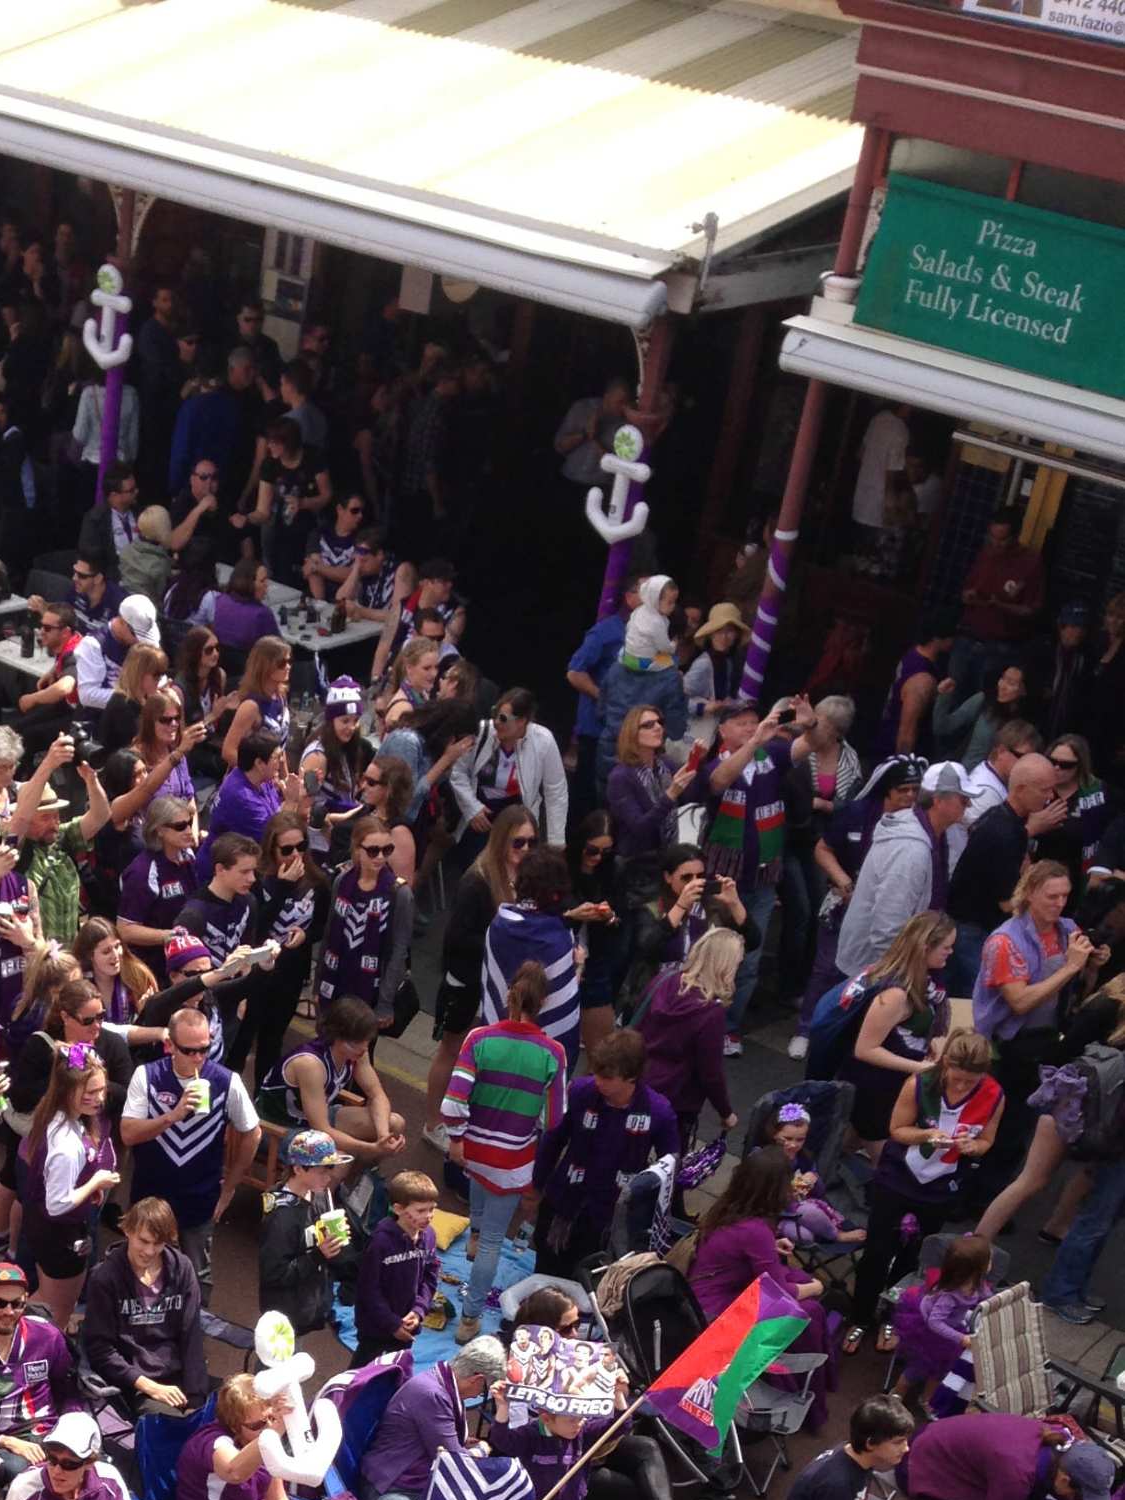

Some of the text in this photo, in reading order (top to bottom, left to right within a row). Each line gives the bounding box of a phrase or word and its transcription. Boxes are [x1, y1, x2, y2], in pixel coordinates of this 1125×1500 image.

[977, 219, 1037, 258] Pizza
[909, 244, 1085, 313] Salads & Steak
[904, 279, 1073, 345] Fully Licensed
[507, 1385, 614, 1416] LET'S GO FREO
